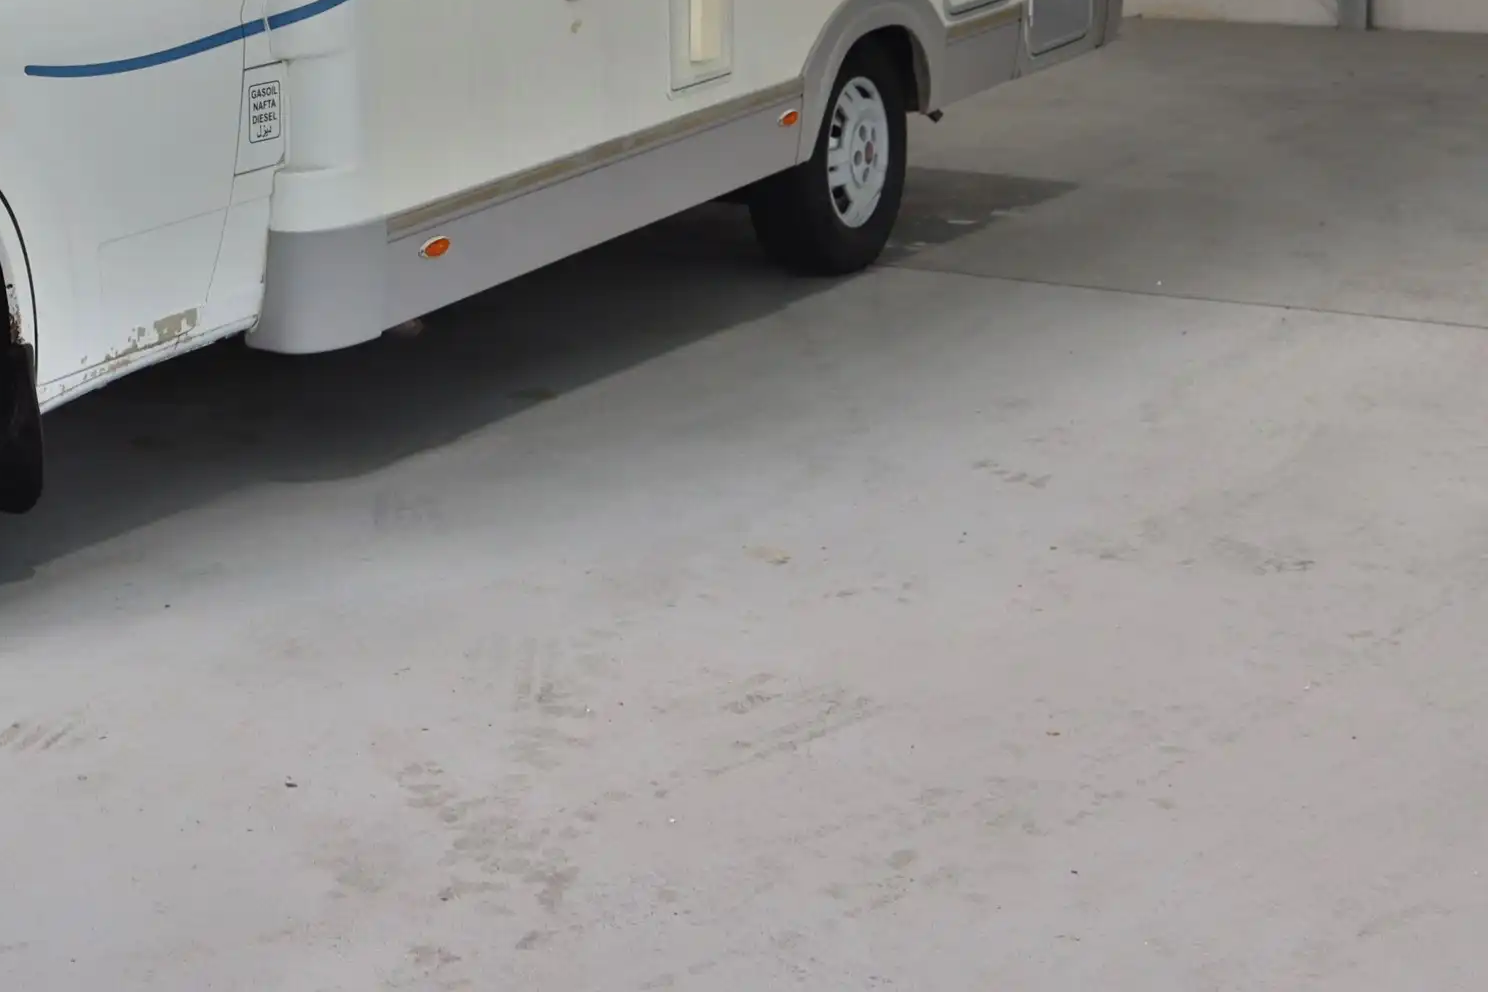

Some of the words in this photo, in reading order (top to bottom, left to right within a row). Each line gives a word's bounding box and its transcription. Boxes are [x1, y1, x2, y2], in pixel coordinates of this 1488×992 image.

[251, 86, 277, 99] GASOIL
[253, 98, 276, 111] NAFTA
[252, 112, 277, 124] DIESEL
